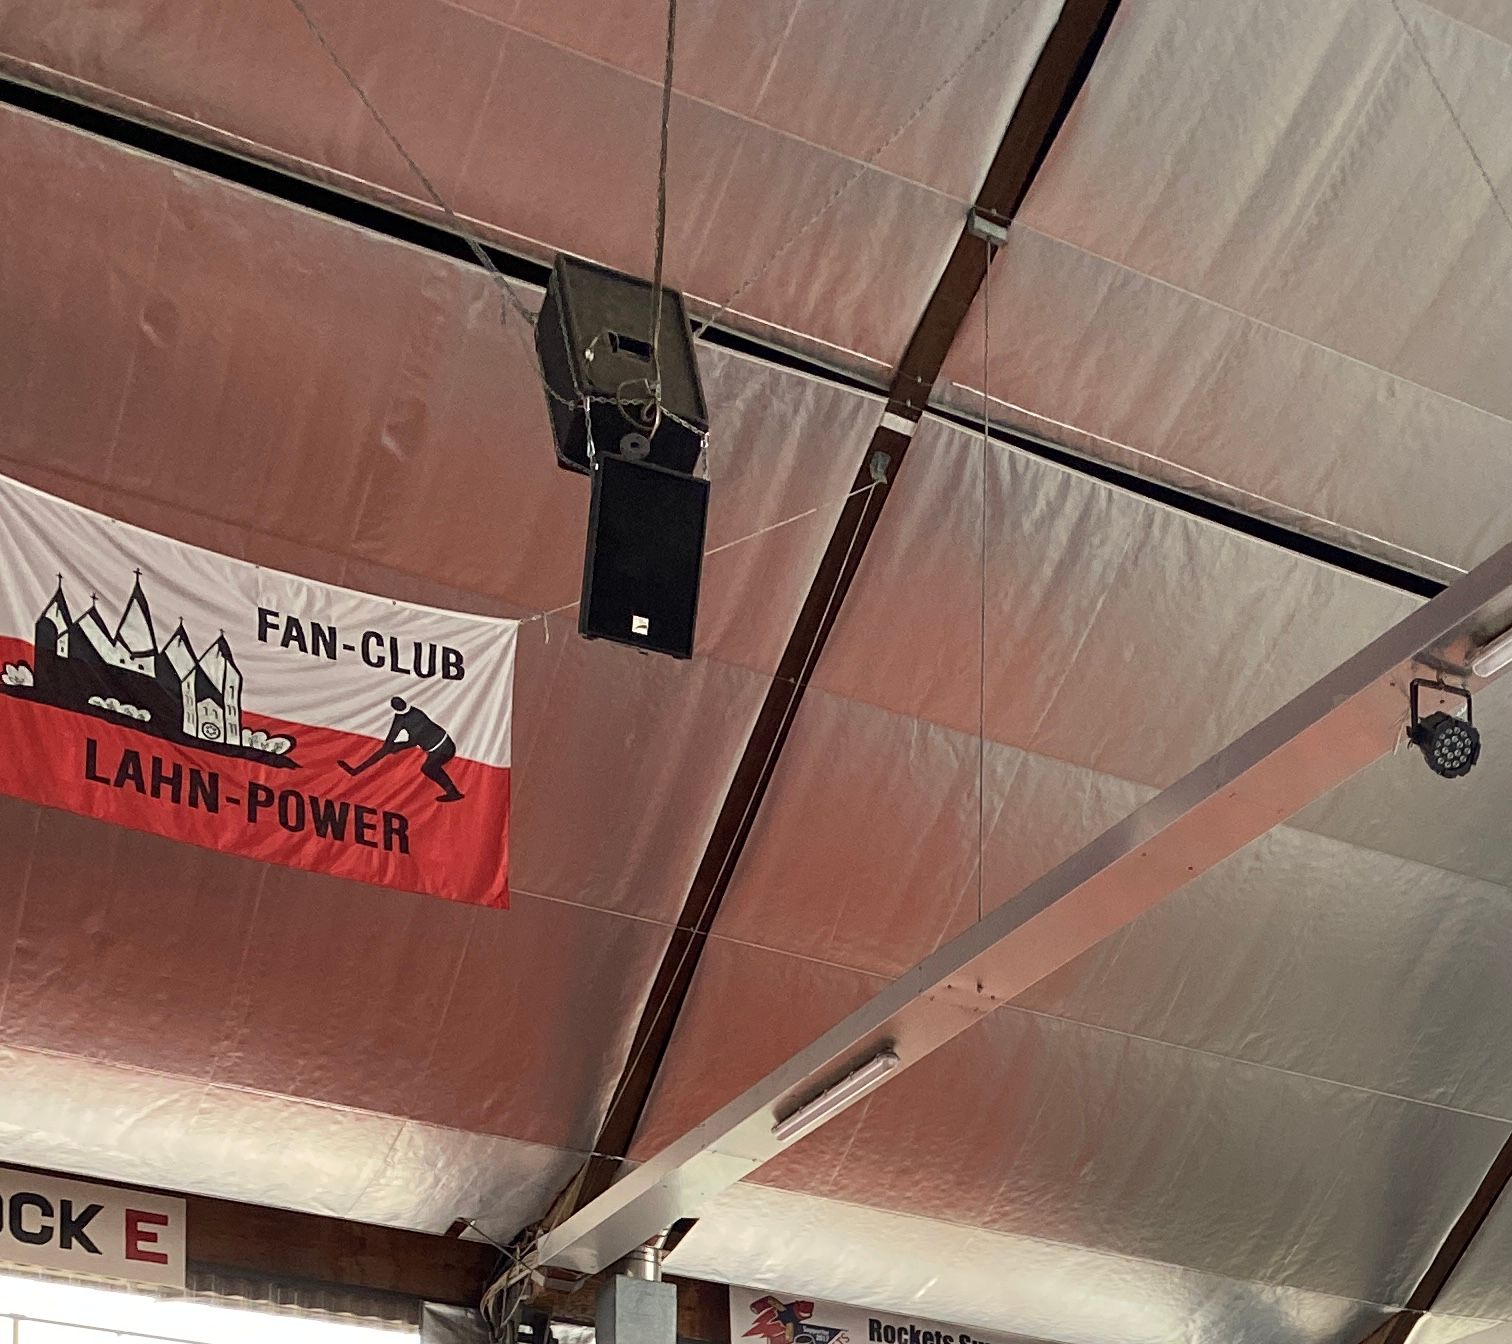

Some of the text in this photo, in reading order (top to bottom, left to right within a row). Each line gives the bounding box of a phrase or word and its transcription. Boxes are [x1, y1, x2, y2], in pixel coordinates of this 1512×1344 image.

[257, 606, 465, 681] FAN-CLUB
[85, 737, 410, 854] LAHN-POWER
[0, 1192, 168, 1264] CK E
